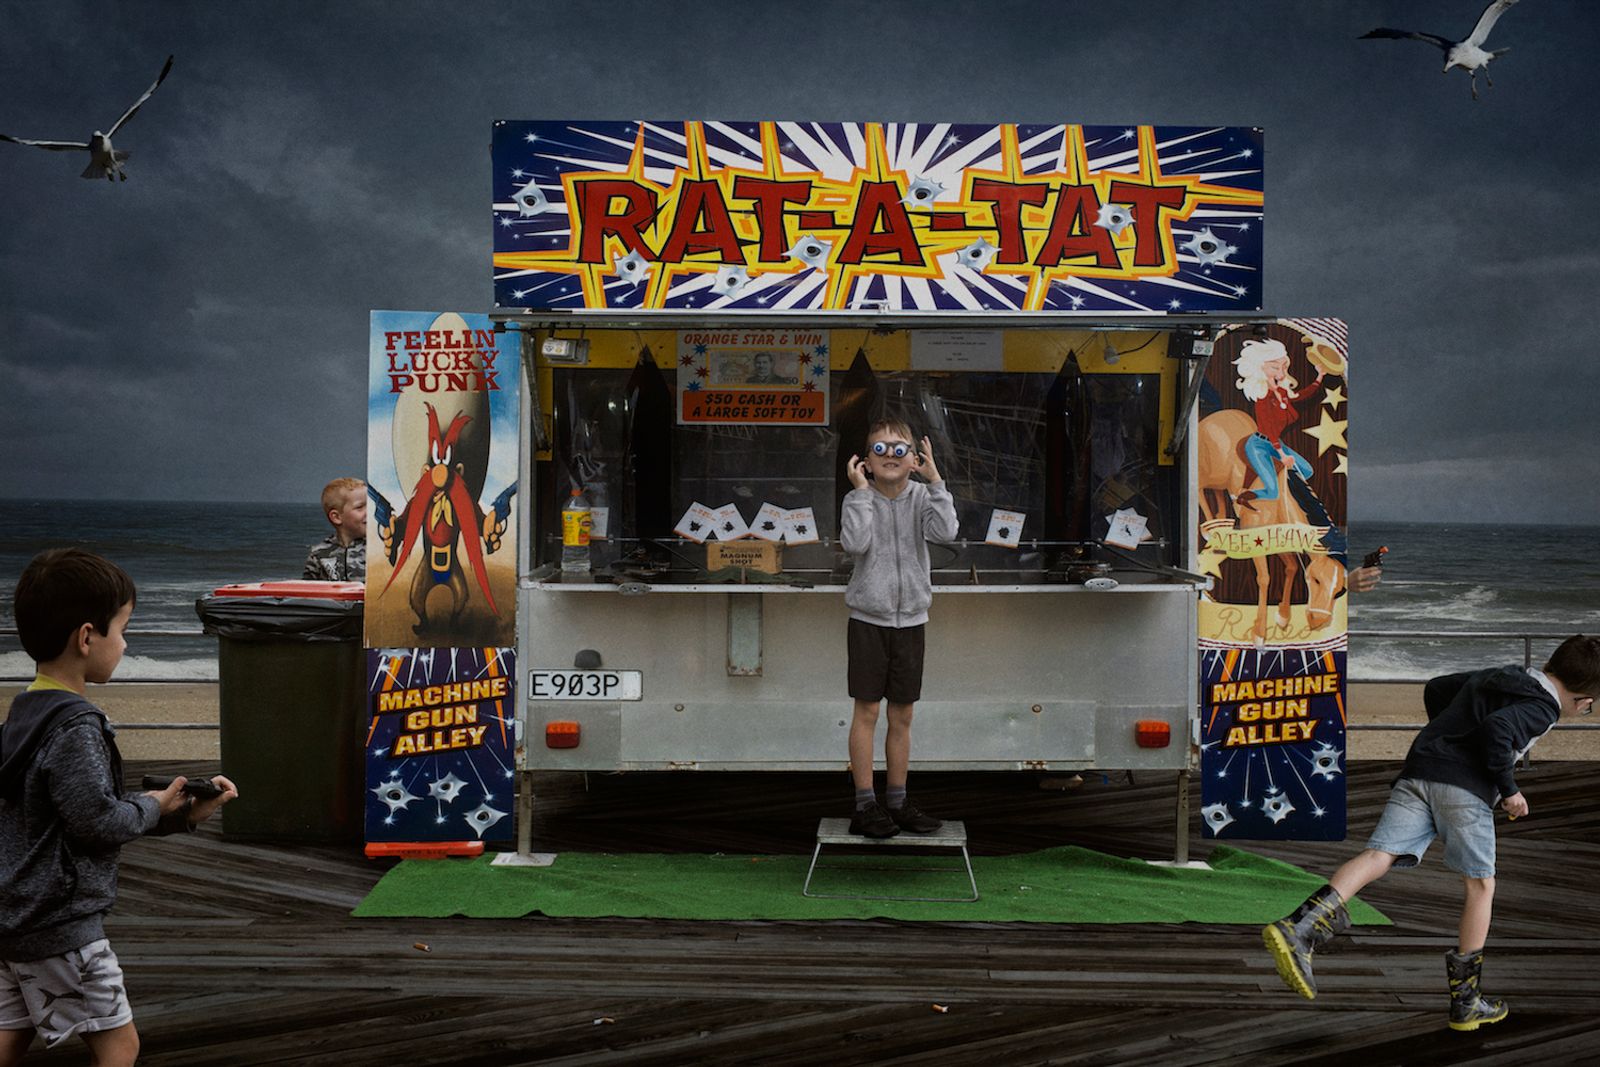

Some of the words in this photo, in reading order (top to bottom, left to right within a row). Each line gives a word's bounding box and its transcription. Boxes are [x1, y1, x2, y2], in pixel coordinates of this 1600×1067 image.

[574, 177, 1189, 267] RAT-A-TAT
[385, 330, 496, 351] FEELIN
[684, 334, 738, 345] ORANGE
[742, 334, 775, 345] STAR
[780, 334, 788, 345] &
[794, 334, 823, 345] WIN
[387, 350, 501, 373] LUCKY
[389, 373, 500, 392] PUNK
[705, 393, 733, 405] $50
[738, 394, 776, 405] CASH
[781, 395, 801, 405] OR
[692, 407, 701, 417] A
[706, 407, 749, 417] LARGE
[753, 408, 788, 418] SOFT
[792, 408, 816, 418] TOY
[1213, 531, 1252, 553] YEE
[1265, 524, 1317, 551] HAW
[379, 677, 507, 711] MACHINE
[1212, 673, 1339, 703] MACHINE
[407, 704, 478, 731] GUN
[1238, 698, 1309, 722] GUN
[394, 725, 488, 756] ALLEY
[1225, 719, 1319, 747] ALLEY
